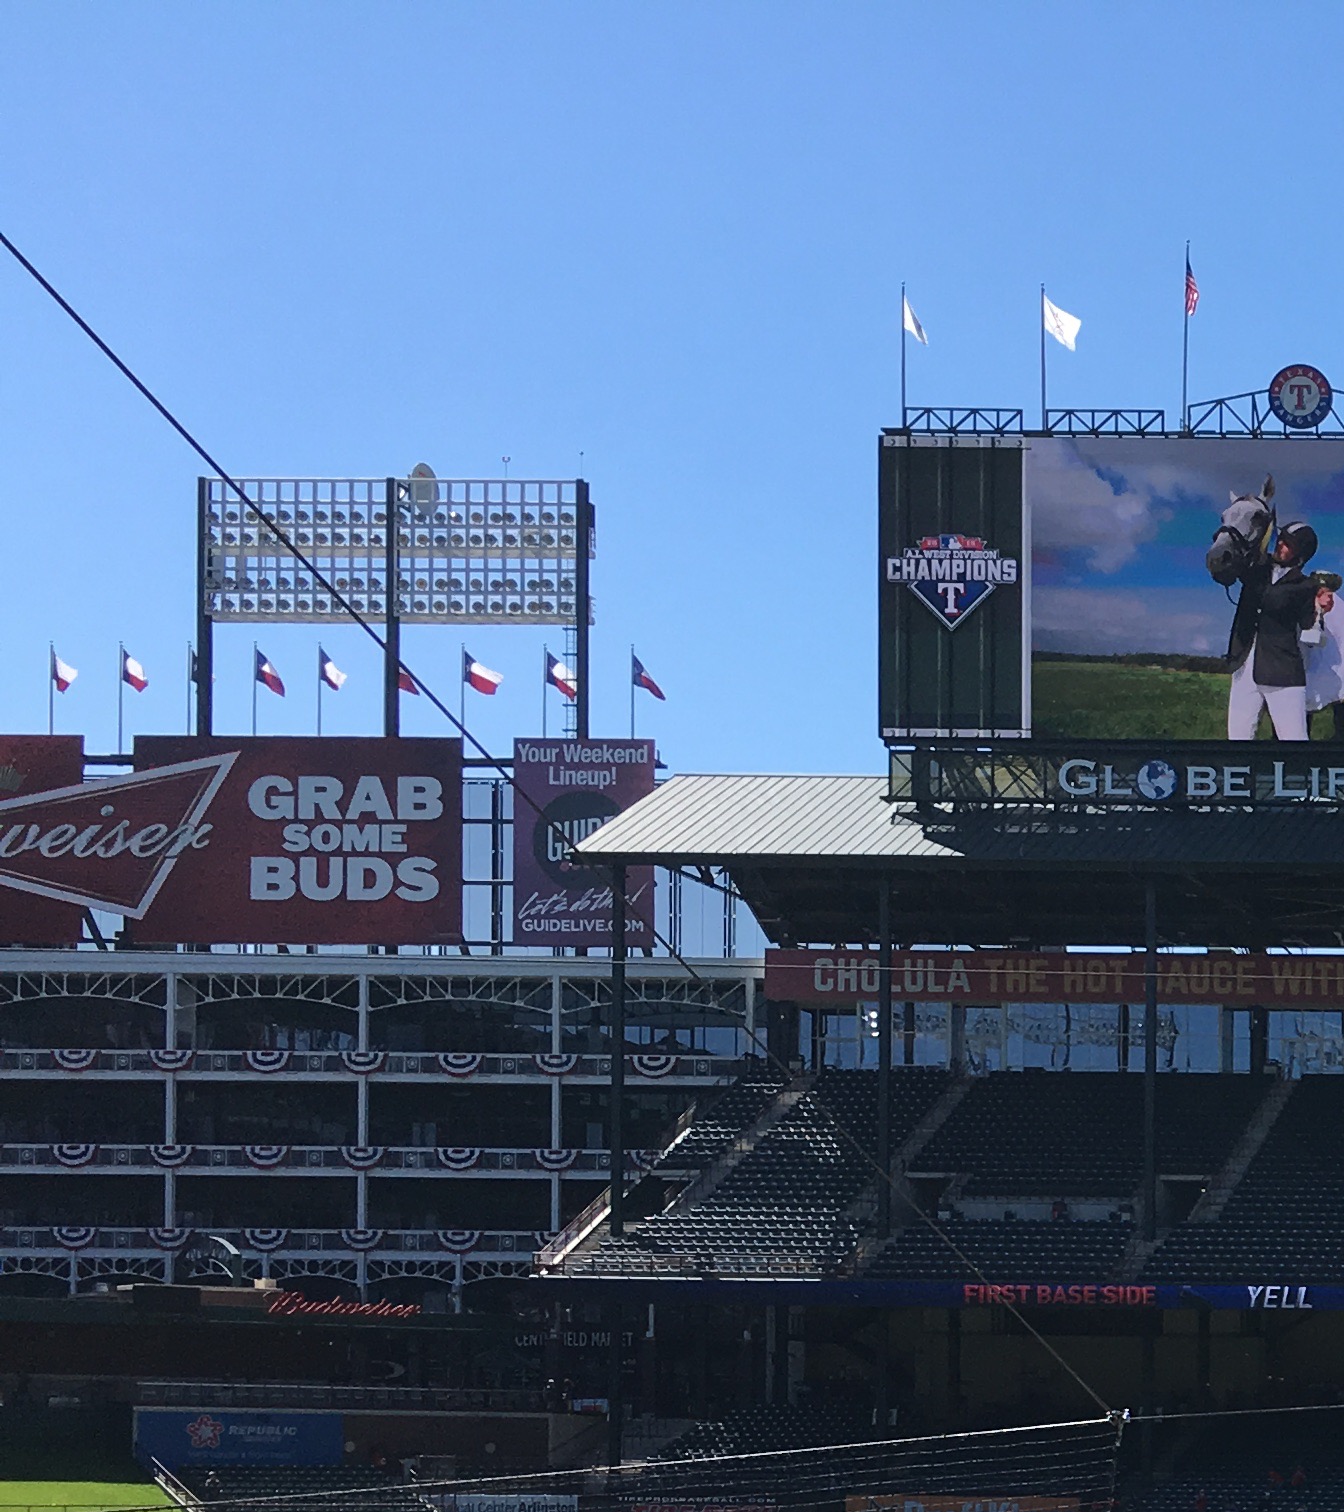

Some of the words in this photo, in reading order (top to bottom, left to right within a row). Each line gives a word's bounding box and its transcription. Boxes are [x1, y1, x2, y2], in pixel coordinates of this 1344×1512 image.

[1279, 368, 1322, 383] TEXAS
[1290, 385, 1311, 410] T
[923, 550, 951, 559] WEST
[953, 550, 997, 559] DIVISION
[887, 558, 1017, 581] CHAMPIONS
[937, 582, 965, 615] T
[518, 743, 557, 763] Your
[563, 743, 649, 764] Weekend
[548, 765, 617, 790] Lineup!
[247, 775, 445, 822] GRAB
[281, 823, 408, 853] SOME
[249, 855, 441, 902] BUDS
[813, 957, 971, 993] CHOULA
[984, 958, 1050, 994] THE
[1062, 959, 1129, 994] HOT
[1144, 960, 1256, 996] AUCE
[963, 1284, 1032, 1305] FIRST
[1037, 1285, 1097, 1305] BASE
[1101, 1285, 1157, 1305] SIDE
[1247, 1285, 1314, 1309] YELL
[228, 1425, 298, 1436] REPUBLIC
